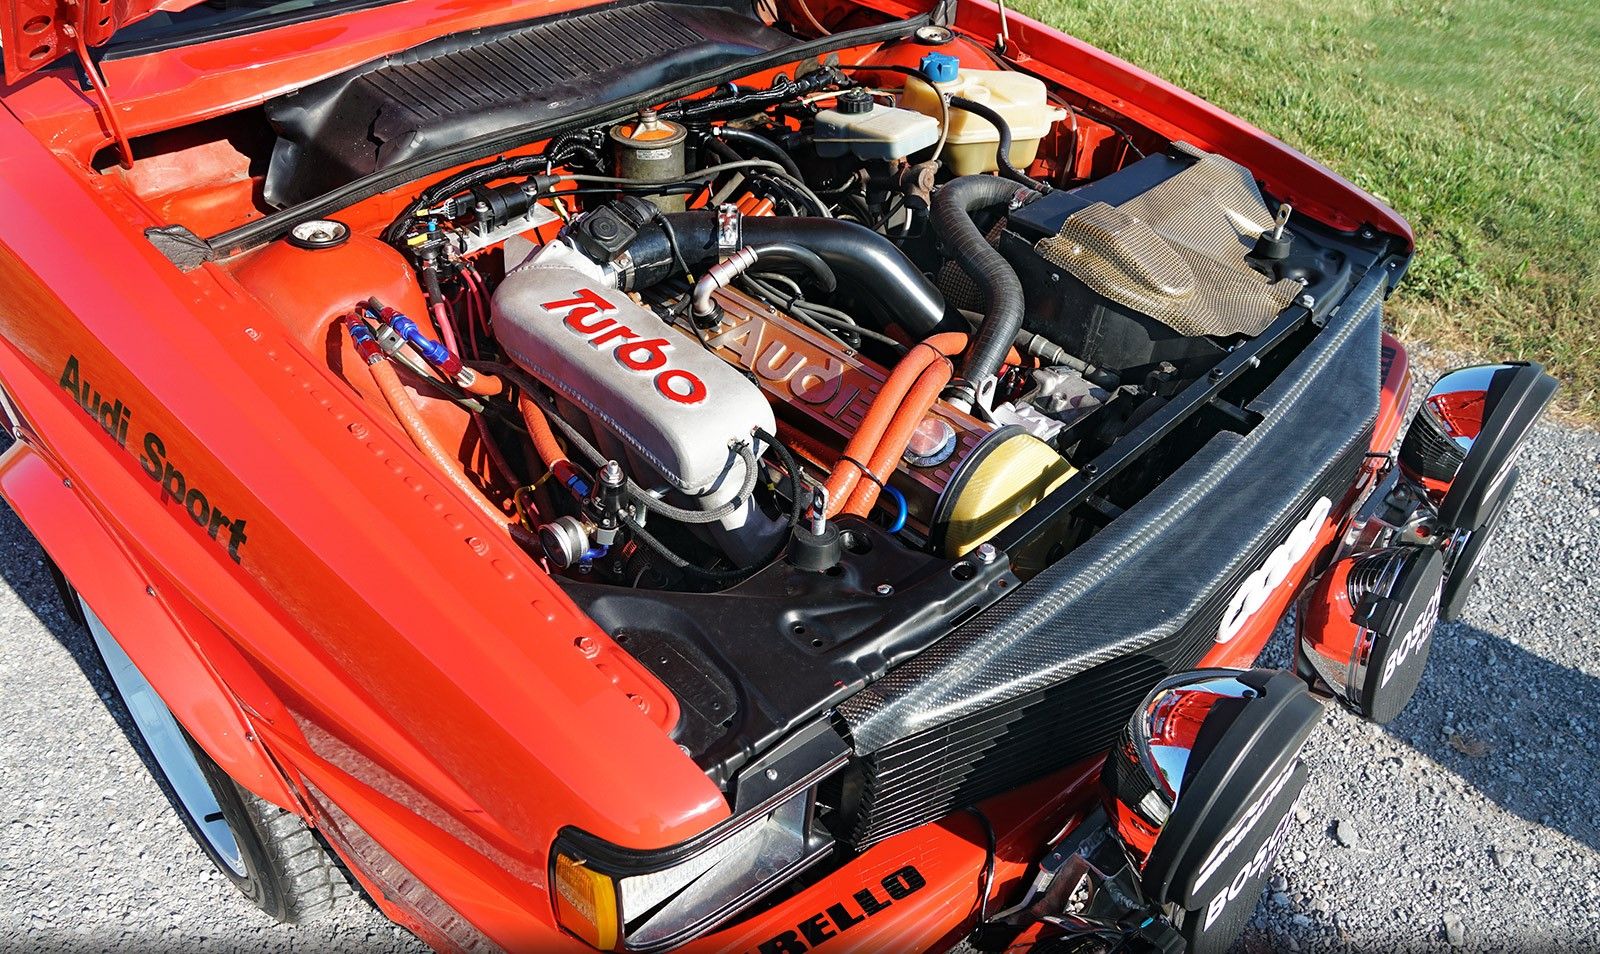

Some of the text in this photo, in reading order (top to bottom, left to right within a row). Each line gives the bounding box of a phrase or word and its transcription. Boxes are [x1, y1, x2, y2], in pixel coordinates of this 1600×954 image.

[540, 287, 707, 406] Turbo
[59, 354, 248, 565] Audi Sport
[743, 865, 927, 954] BELLO
